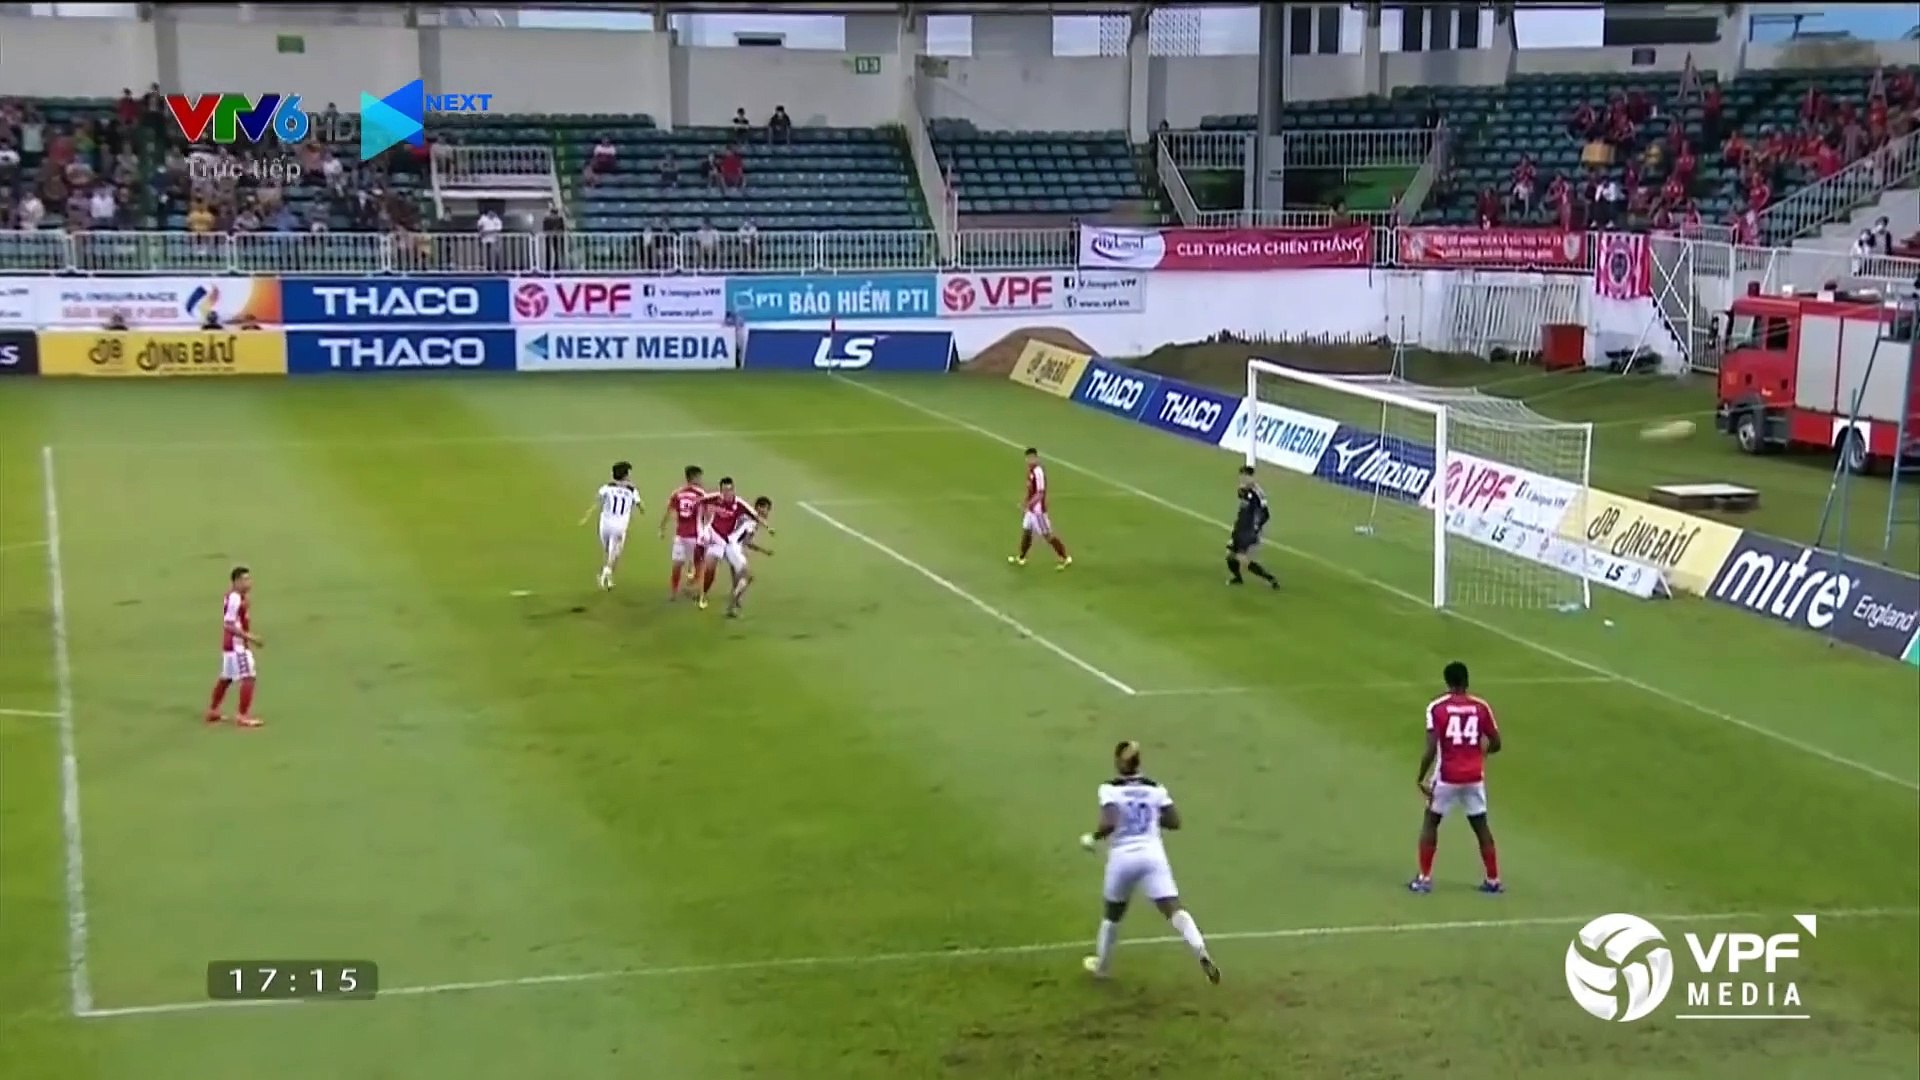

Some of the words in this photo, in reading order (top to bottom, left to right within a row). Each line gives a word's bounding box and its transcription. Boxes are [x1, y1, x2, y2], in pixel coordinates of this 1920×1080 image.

[1177, 242, 1204, 257] CLB
[312, 286, 480, 316] THACO
[555, 283, 632, 313] VPF
[756, 292, 783, 309] PTI
[789, 282, 831, 314] BẢO
[837, 280, 891, 313] HIỂM
[897, 288, 929, 312] PTI
[980, 276, 1053, 306] VPF
[317, 336, 486, 367] THACO
[555, 335, 631, 360] NEXT
[636, 335, 730, 360] MEDIA
[813, 337, 876, 369] LS
[1085, 368, 1145, 411] THACO
[1158, 391, 1222, 433] THACO
[1277, 421, 1328, 459] MEDIA
[1460, 463, 1516, 514] VPF
[612, 496, 627, 516] 11
[1491, 525, 1508, 543] LS
[1604, 562, 1625, 582] LS
[1715, 548, 1853, 629] mitre
[1853, 594, 1917, 632] England
[1445, 715, 1479, 746] 44
